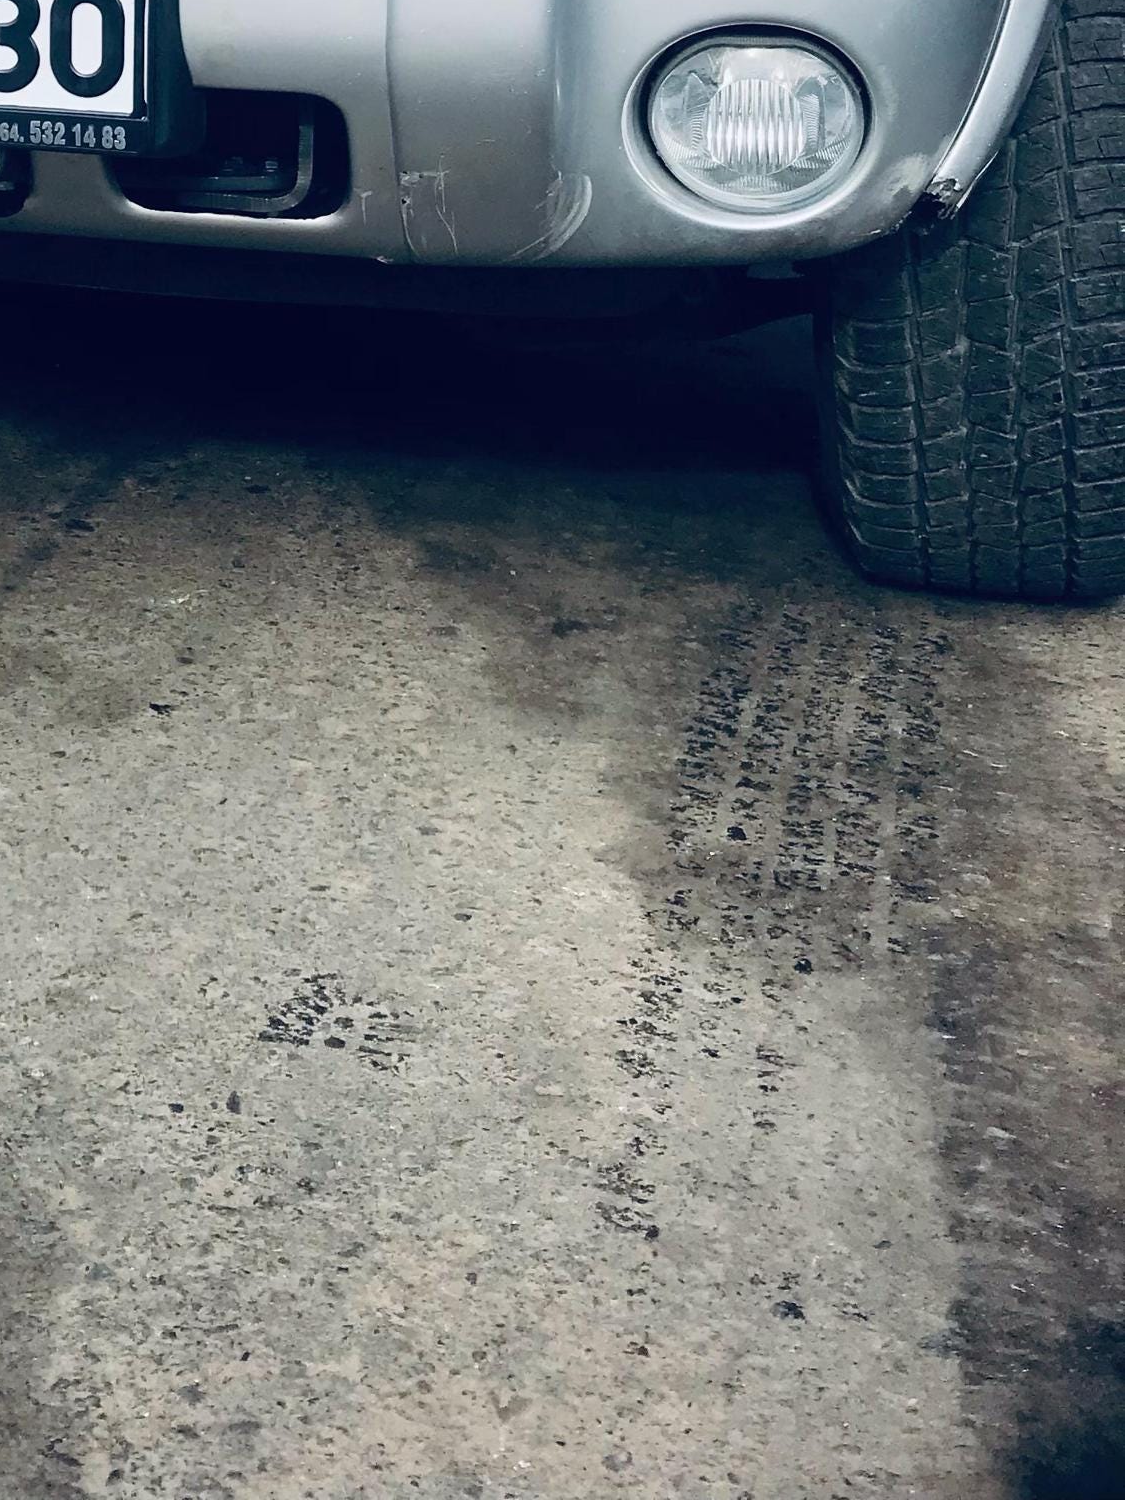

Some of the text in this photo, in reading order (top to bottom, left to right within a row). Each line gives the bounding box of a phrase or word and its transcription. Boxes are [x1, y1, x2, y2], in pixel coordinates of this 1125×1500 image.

[29, 120, 66, 146] 532
[72, 123, 96, 148] 14
[101, 125, 127, 150] 83
